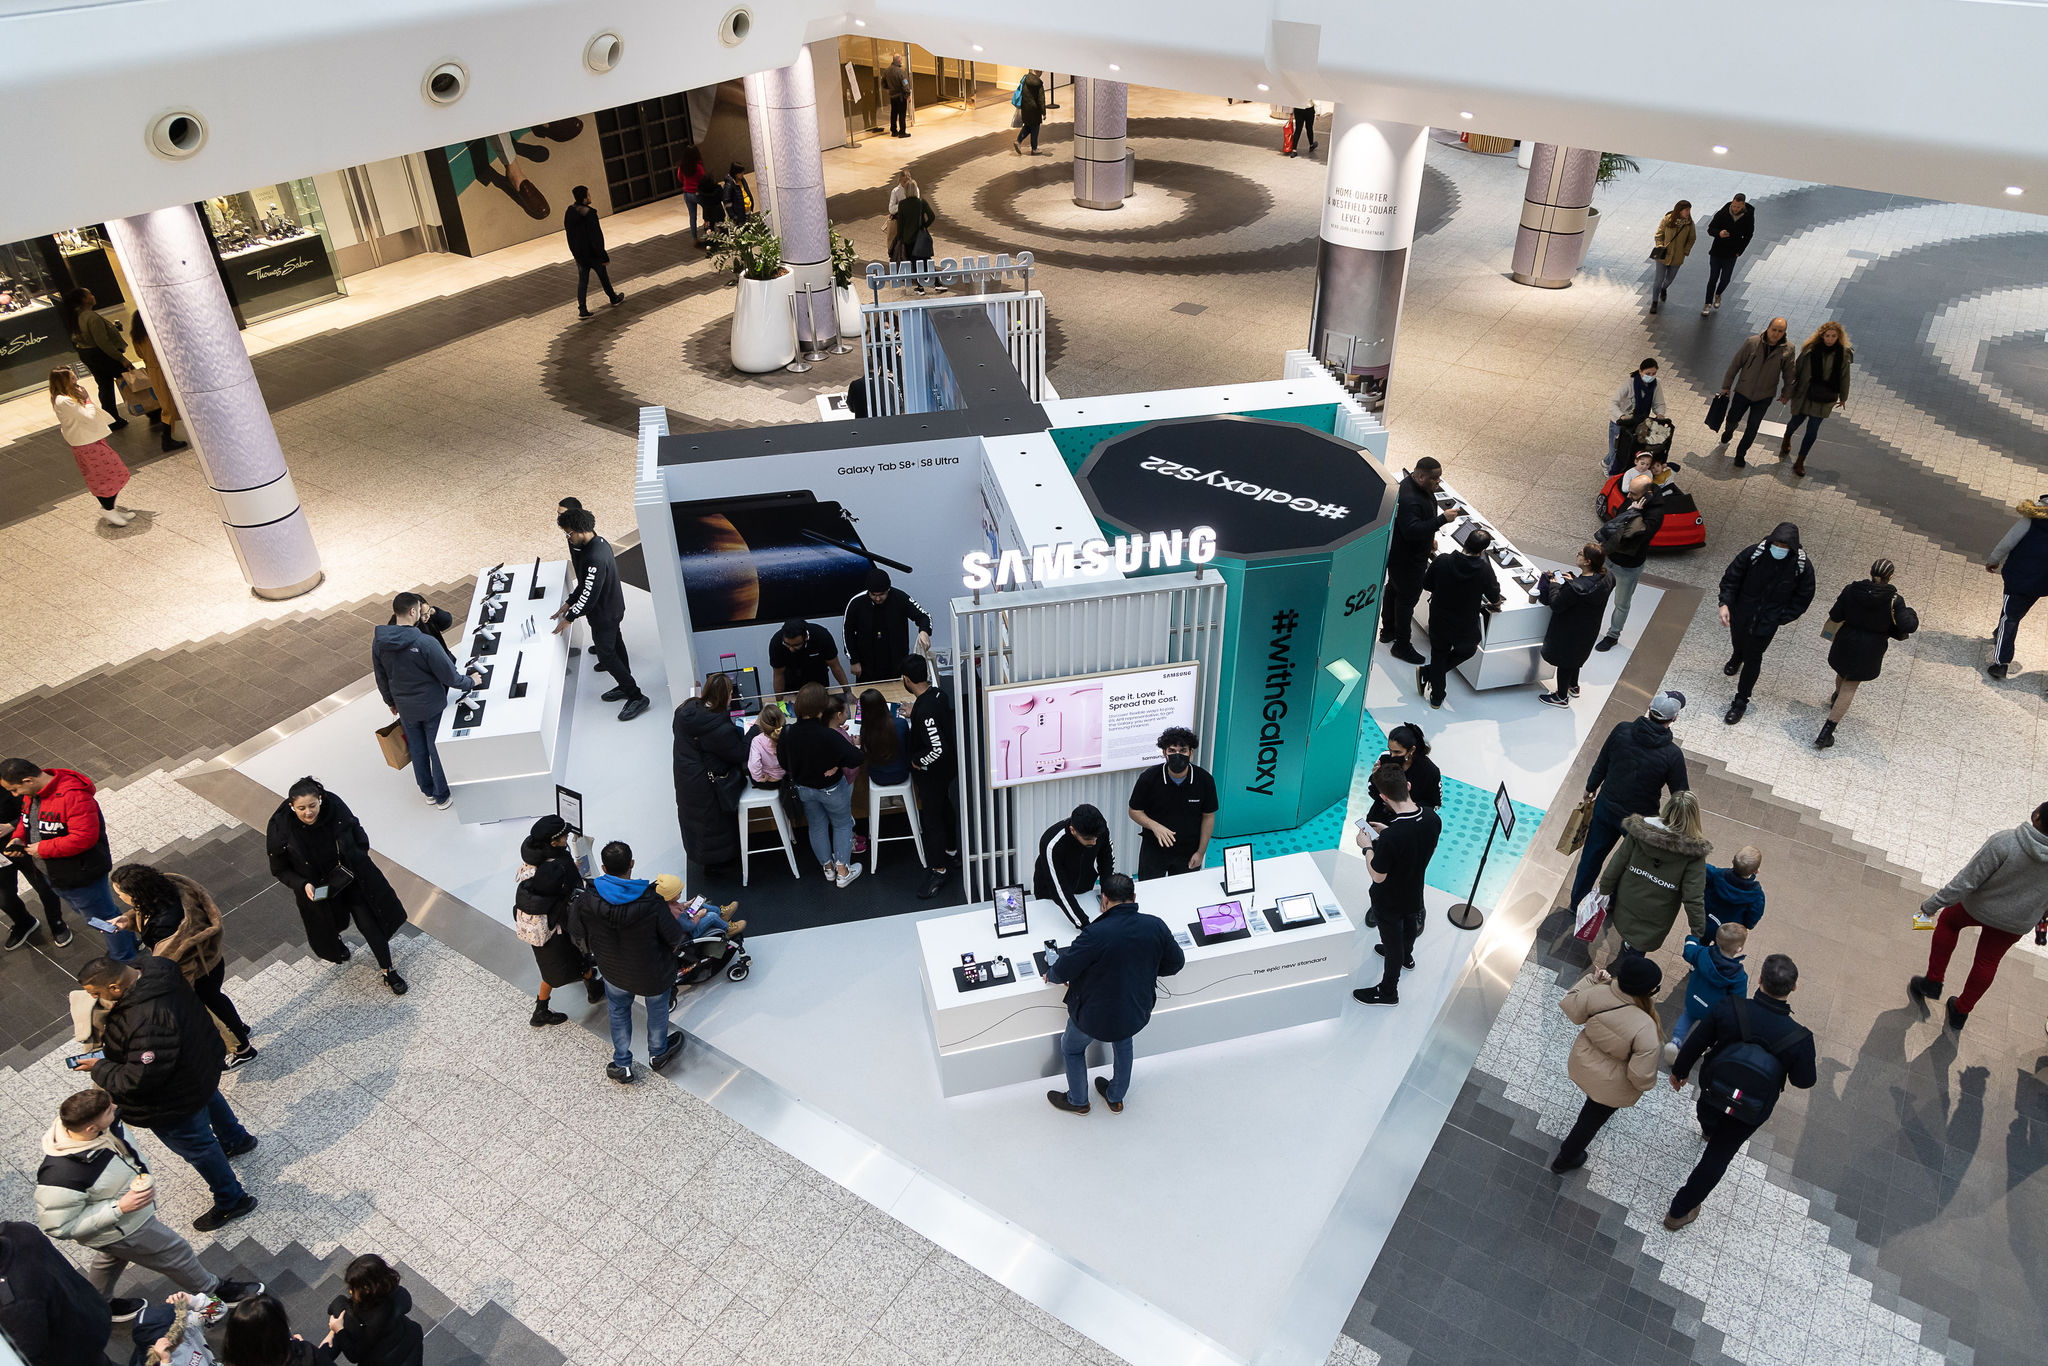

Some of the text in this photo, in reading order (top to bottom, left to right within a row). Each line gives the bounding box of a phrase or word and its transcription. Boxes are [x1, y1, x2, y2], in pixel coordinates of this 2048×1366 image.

[1336, 186, 1388, 202] HOME QUARTER
[1332, 199, 1366, 212] WESTFIELD
[1368, 205, 1398, 215] SQUARE
[1342, 212, 1361, 224] LEVEL
[247, 256, 314, 280] Thomas Sabo
[8, 332, 48, 354] Sabo
[838, 457, 959, 475] Galaxy Tab S8+ S8 Ultra
[1140, 456, 1350, 520] #GalaxyS22
[962, 525, 1217, 589] SAMSUNG
[572, 566, 597, 614] SAMSUNG
[1344, 584, 1377, 617] S22
[1109, 700, 1140, 711] Spread
[1110, 694, 1126, 702] See
[1246, 608, 1299, 796] #withGalaxy
[920, 718, 943, 766] SAMSUNG
[1297, 956, 1328, 966] standard
